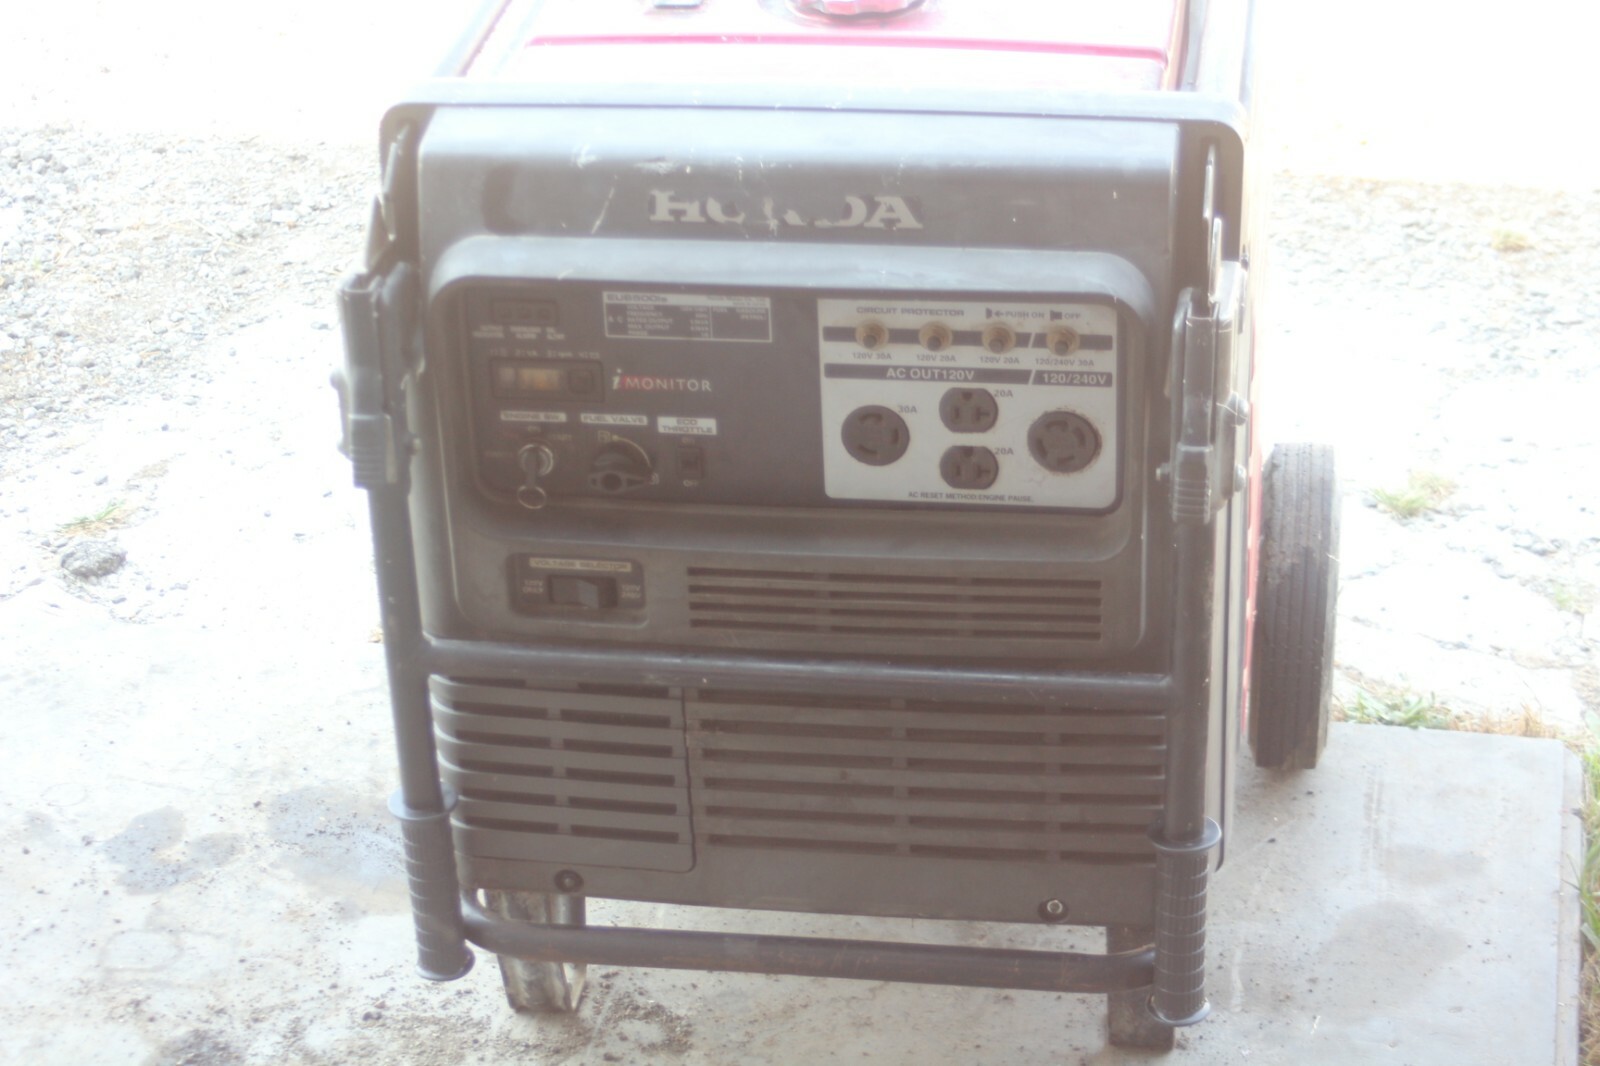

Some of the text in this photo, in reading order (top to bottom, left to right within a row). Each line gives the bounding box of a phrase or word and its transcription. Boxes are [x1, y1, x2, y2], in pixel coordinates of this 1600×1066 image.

[856, 306, 965, 317] CIRCUIT PROTECTOR
[1005, 310, 1046, 319] PUSH ON
[1064, 312, 1081, 320] OFF
[852, 351, 893, 361] 120V 30A
[916, 353, 957, 362] 120V 20A
[979, 355, 1020, 365] 120V 20A
[1035, 357, 1095, 367] 120/240V 30A
[886, 366, 906, 379] AC
[1042, 371, 1108, 385] 120/240V
[625, 376, 713, 392] MONITOR
[994, 388, 1014, 398] 20A
[898, 404, 918, 414] 30A
[582, 414, 646, 424] FUEL VALVE
[675, 417, 698, 426] ECO
[661, 425, 714, 434] THROTTLE
[994, 447, 1014, 456] 20A
[908, 490, 920, 498] AC
[920, 491, 943, 500] RESET
